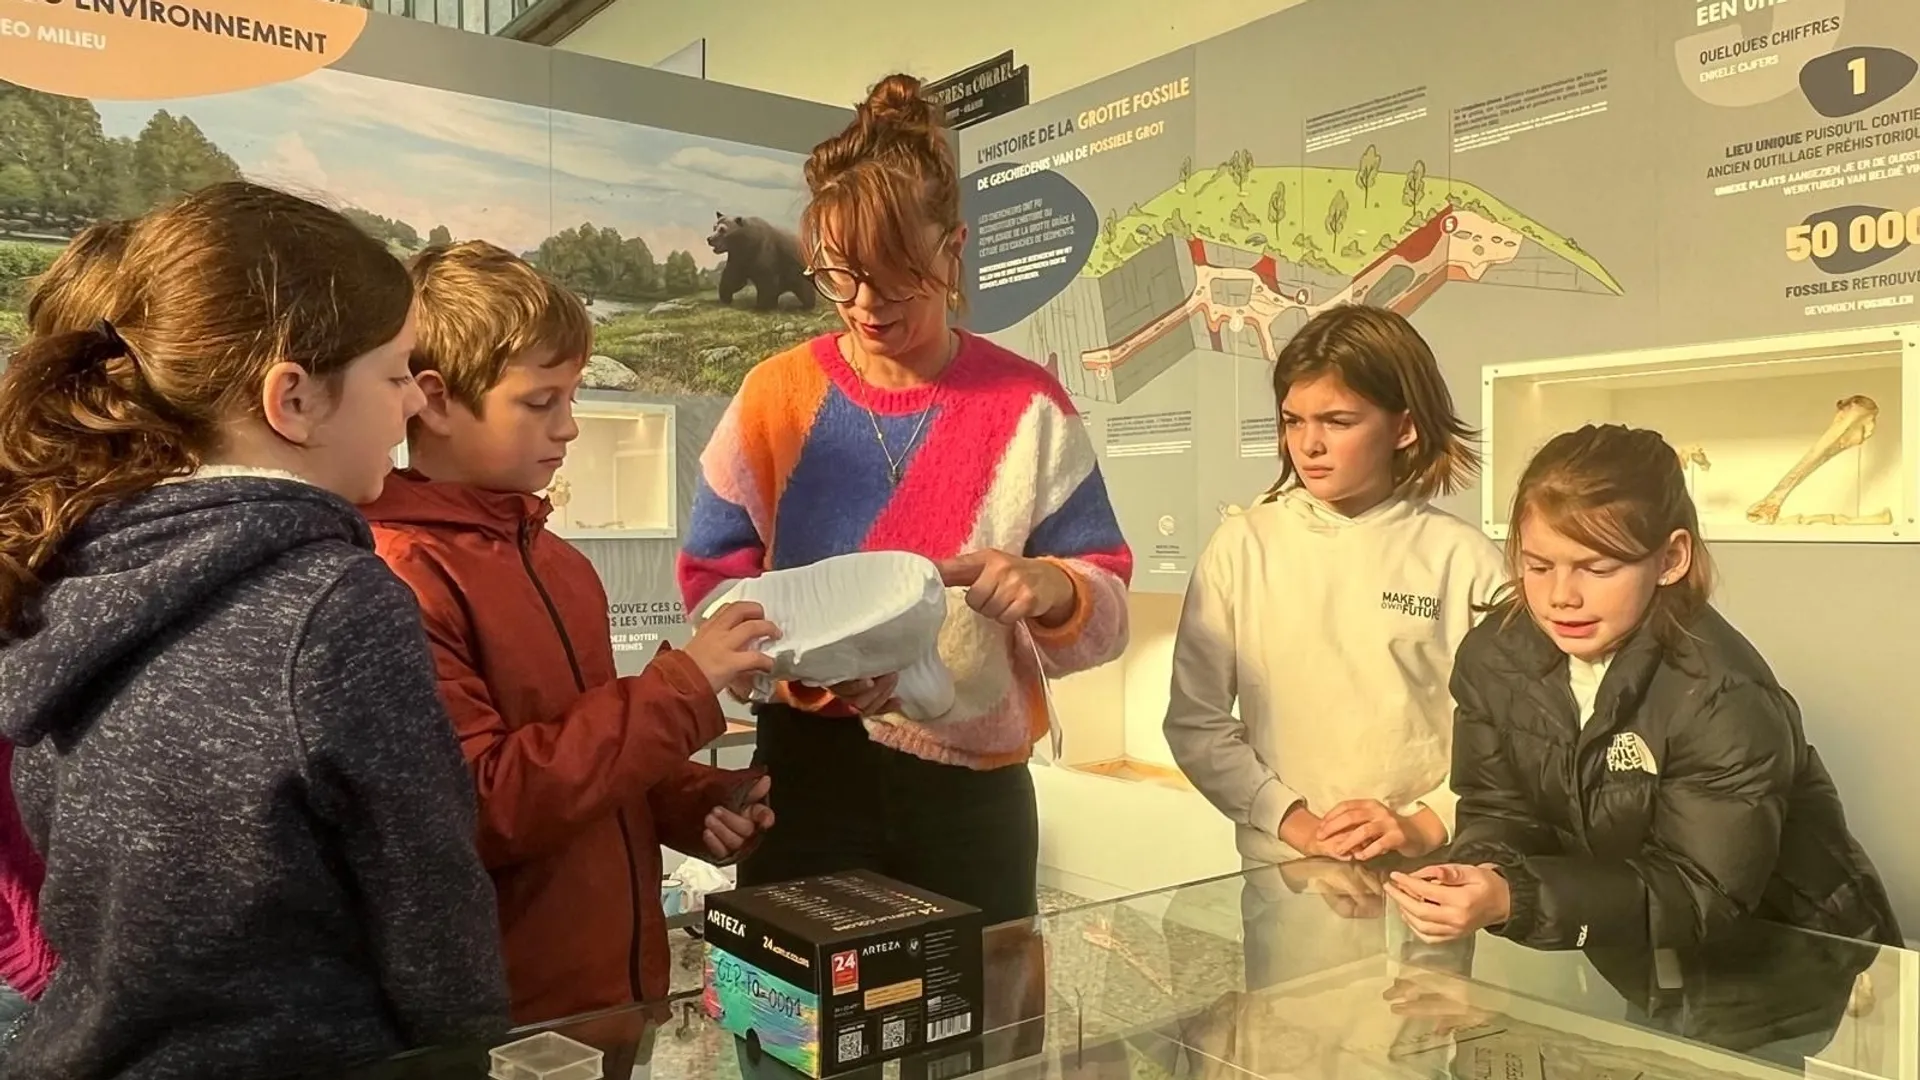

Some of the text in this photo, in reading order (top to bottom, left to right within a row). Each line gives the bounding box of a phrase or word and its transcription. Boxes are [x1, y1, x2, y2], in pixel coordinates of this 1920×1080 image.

[1696, 0, 1738, 27] EEN
[37, 25, 106, 50] MILIEU
[1700, 16, 1840, 65] QUELQUES CHIFFRES
[1699, 64, 1736, 83] ENKELE
[1847, 57, 1866, 95] 1
[977, 77, 1190, 165] L'HISTOIRE DE LA GROTTE FOSSILE
[1725, 106, 1920, 158] LIEU UNIQUE PUISQU'IL CONTIE
[977, 121, 1164, 191] DE GESCHIEDENIS VAN DE FOSSIELE GROT
[1706, 159, 1751, 180] ANCIEN
[1753, 145, 1823, 171] OUTILLAGE
[1748, 174, 1786, 190] PLAATS
[1788, 164, 1841, 184] AANGEZIEN
[1842, 161, 1856, 173] JE
[1857, 159, 1871, 171] ER
[1872, 156, 1886, 167] DE
[1783, 178, 1845, 197] WERKTUIGEN
[1846, 172, 1867, 185] VAN
[1868, 164, 1905, 181] BELGIË
[1445, 216, 1454, 231] 5
[1785, 220, 1839, 262] 50
[1785, 279, 1849, 299] FOSSILES
[1804, 301, 1857, 316] GEVONDEN
[610, 603, 648, 614] OUVEZ
[651, 602, 670, 613] CES
[1382, 591, 1415, 605] MAKE
[620, 616, 637, 627] LES
[640, 614, 687, 626] VITRINES
[1402, 604, 1440, 620] FUTUR
[1608, 757, 1643, 772] FACE
[707, 909, 746, 937] ARTEZA
[762, 935, 773, 950] 24
[862, 941, 901, 956] ARTEZA
[834, 953, 856, 972] 24
